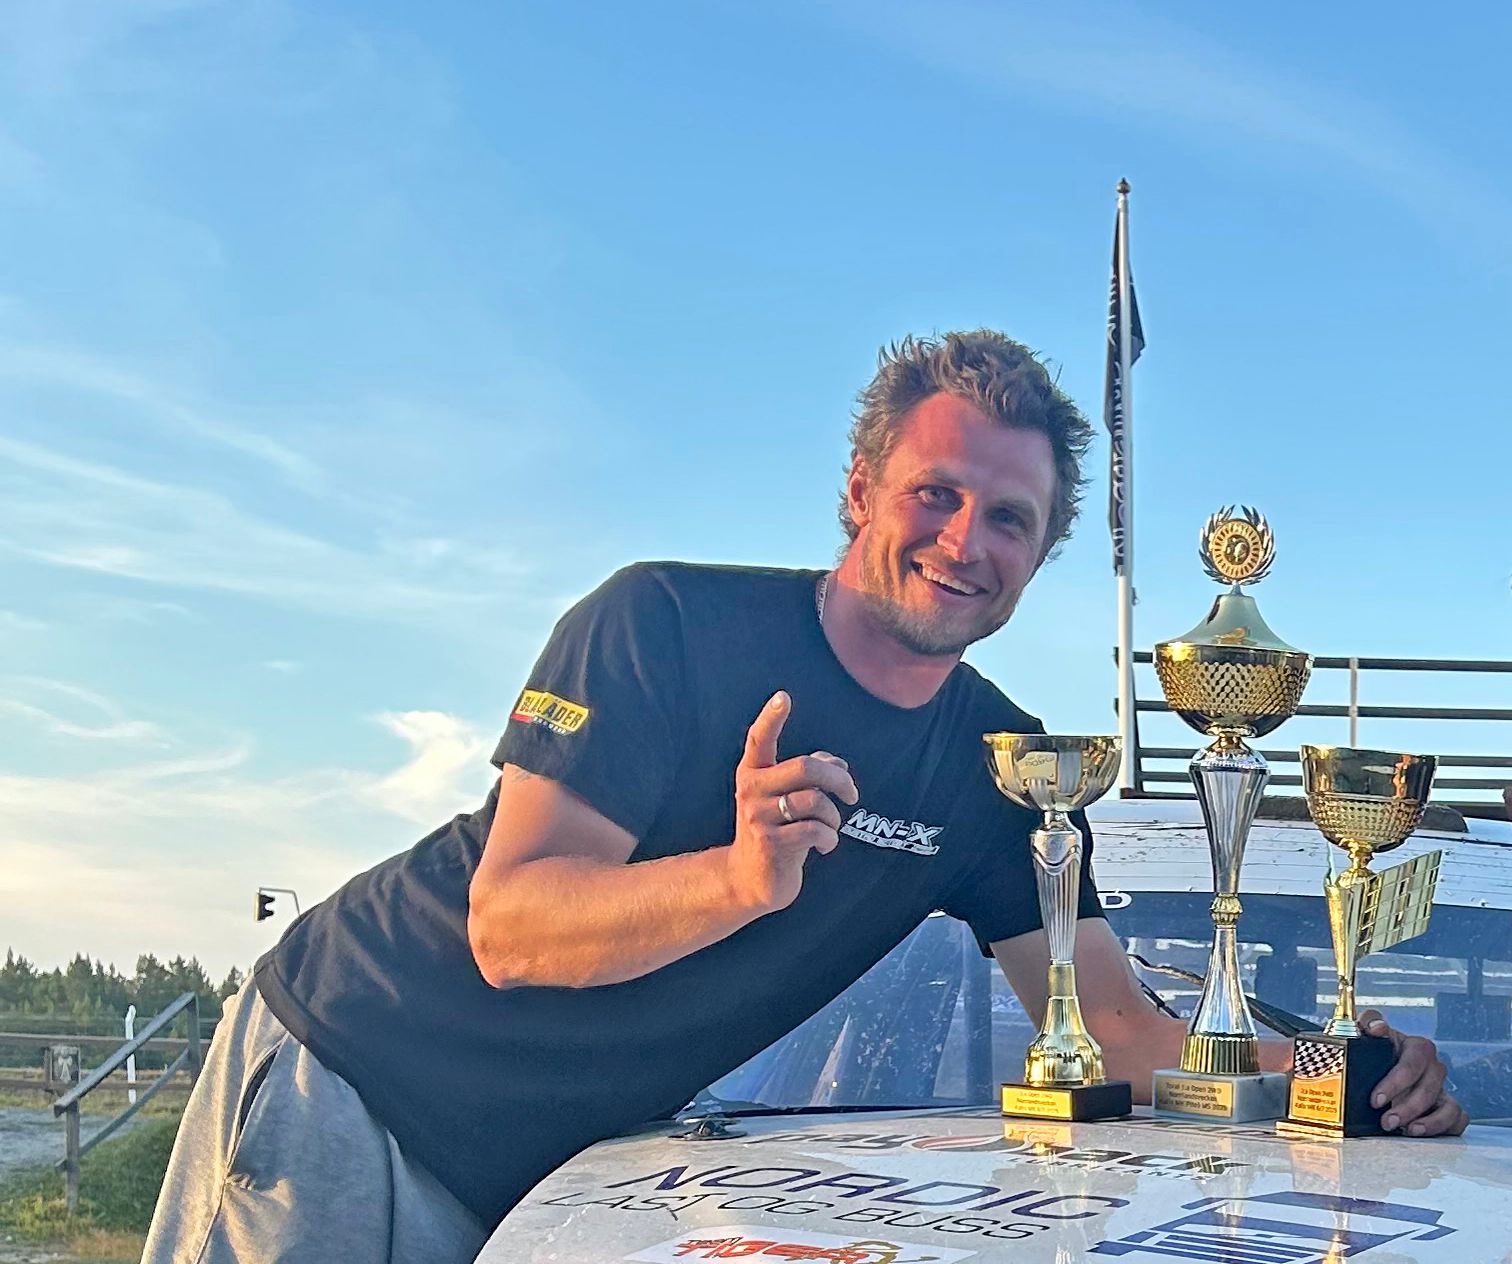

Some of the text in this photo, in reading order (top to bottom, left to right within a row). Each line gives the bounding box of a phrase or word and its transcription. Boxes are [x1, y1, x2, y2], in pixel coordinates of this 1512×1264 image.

[847, 808, 945, 847] MN-X
[540, 1192, 1050, 1239] LAST OG BUSS
[604, 1165, 1130, 1220] NORDIC
